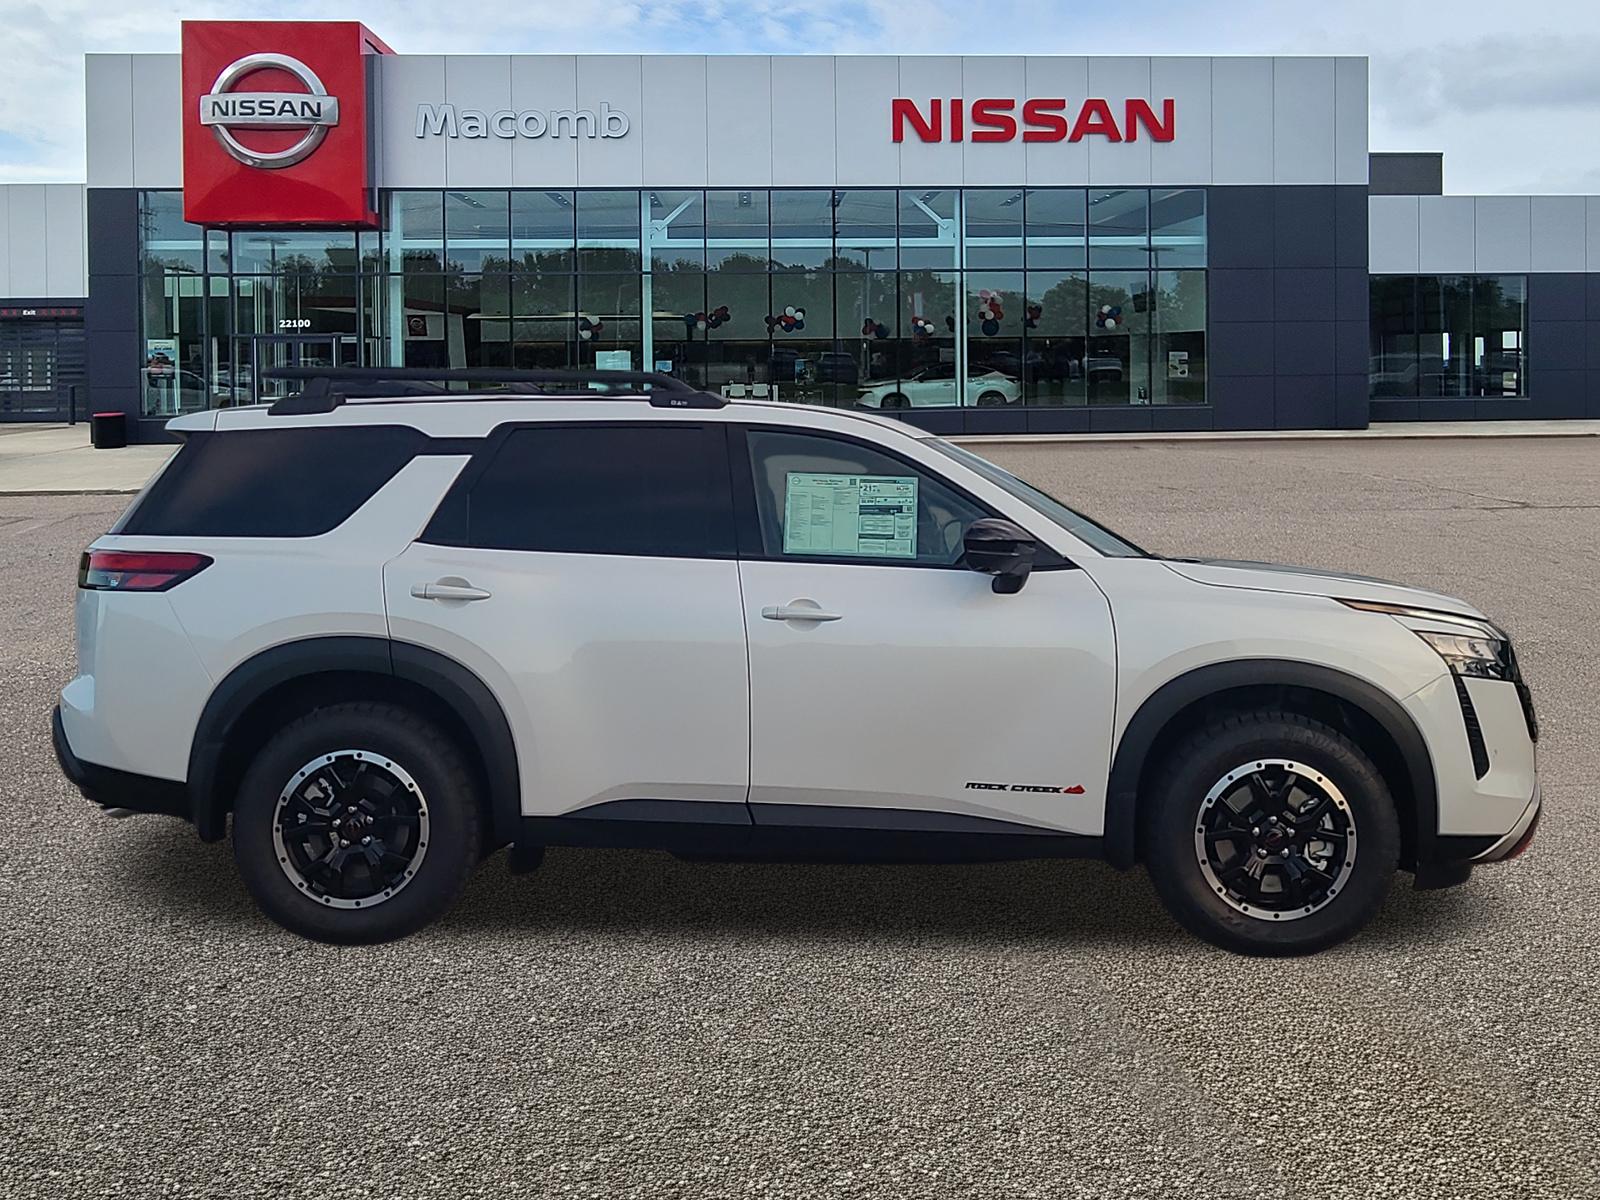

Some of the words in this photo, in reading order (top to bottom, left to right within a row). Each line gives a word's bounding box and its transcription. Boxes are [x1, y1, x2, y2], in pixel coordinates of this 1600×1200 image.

[212, 100, 322, 117] NISSAN
[415, 102, 630, 138] Macomb
[892, 98, 1175, 142] NISSAN
[279, 319, 311, 328] 22100
[964, 782, 1009, 792] ROCK
[1010, 784, 1063, 794] CREEK
